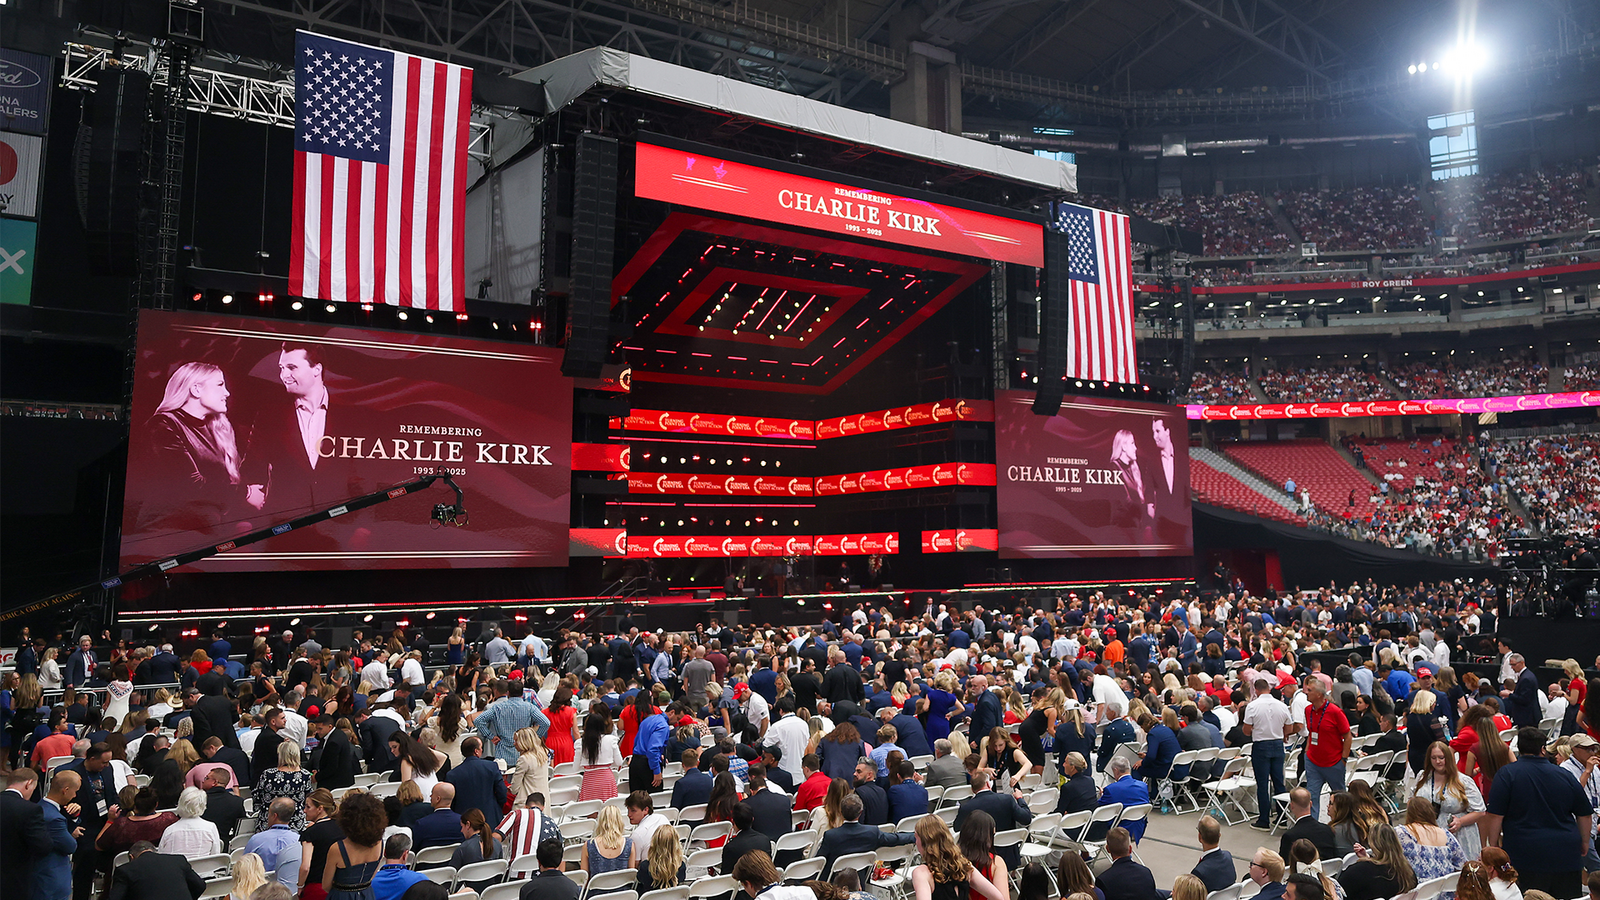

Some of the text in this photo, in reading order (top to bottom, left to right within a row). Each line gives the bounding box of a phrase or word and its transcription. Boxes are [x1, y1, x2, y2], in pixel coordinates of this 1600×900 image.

[0, 96, 19, 106] NA
[834, 188, 892, 205] REMEMBERING
[778, 190, 942, 236] CHARLIE KIRK
[845, 224, 860, 232] 1993
[867, 228, 882, 236] 2025
[400, 425, 482, 436] REMEMBERING
[316, 436, 552, 465] CHARLIE KIRK
[1047, 457, 1089, 465] REMEMBERING
[1008, 465, 1124, 485] CHARLIE KIRK
[25, 601, 50, 613] GREAT
[51, 593, 74, 605] AGAIN
